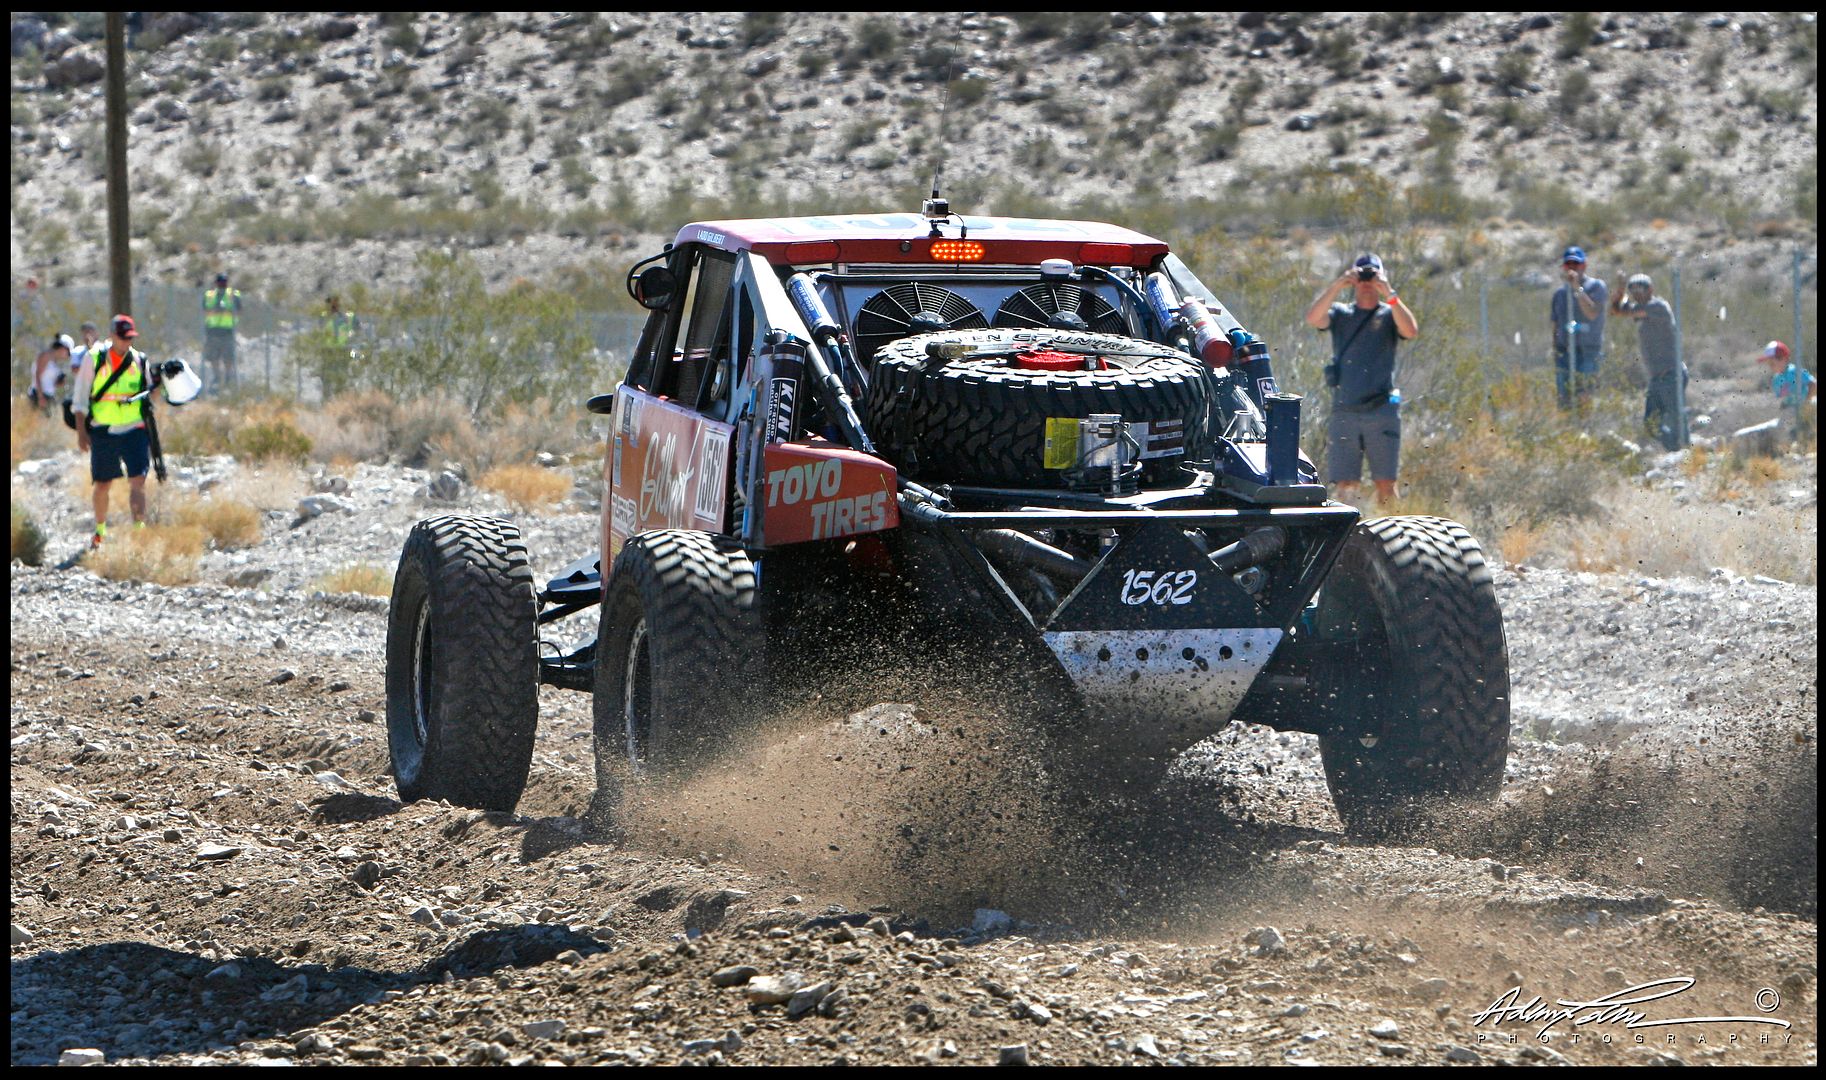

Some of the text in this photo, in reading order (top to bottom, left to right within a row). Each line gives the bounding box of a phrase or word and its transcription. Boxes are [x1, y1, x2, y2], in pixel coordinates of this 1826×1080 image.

[798, 286, 815, 311] OFF-ROAD
[771, 392, 779, 437] OFF-ROAD
[768, 458, 842, 507] TOYO
[811, 491, 886, 540] TIRES
[1120, 568, 1197, 605] 1562
